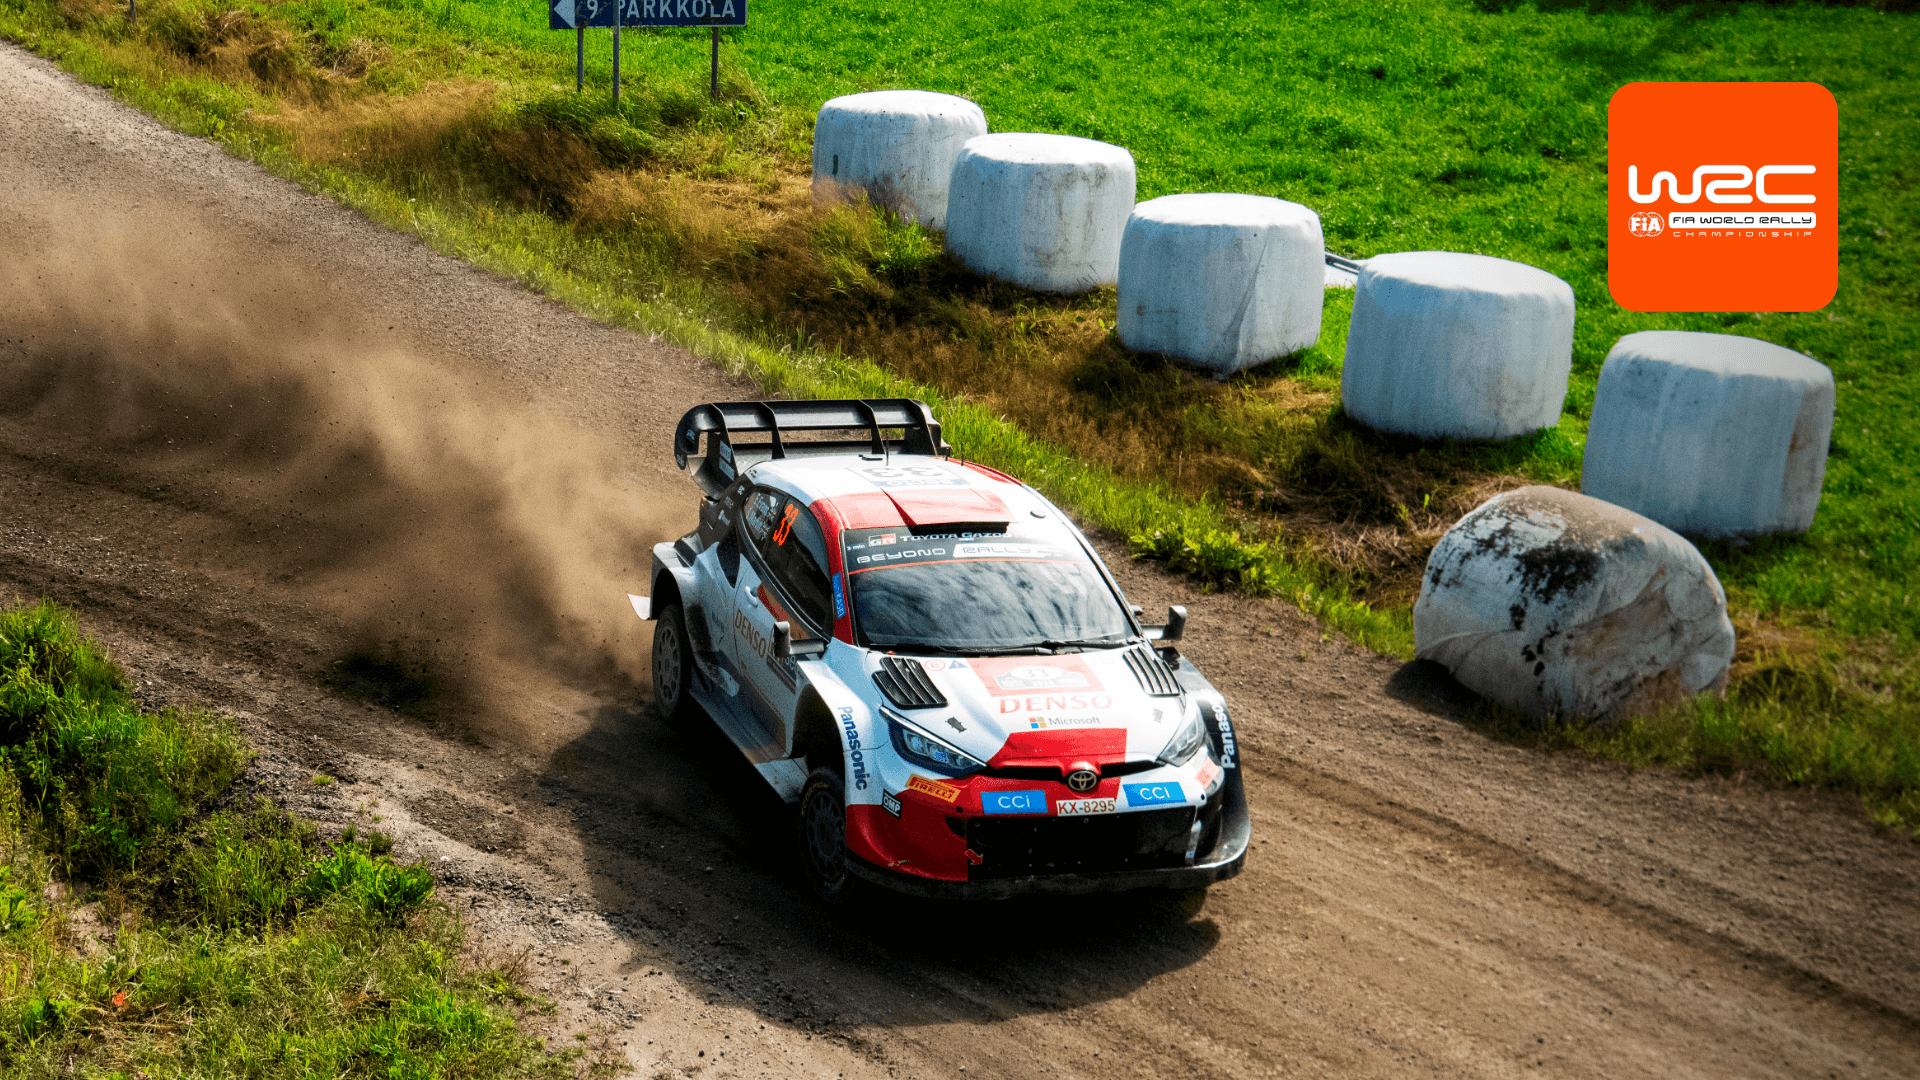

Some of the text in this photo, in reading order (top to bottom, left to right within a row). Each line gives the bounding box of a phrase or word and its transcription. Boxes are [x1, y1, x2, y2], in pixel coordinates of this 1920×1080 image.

[586, 0, 599, 19] 9
[773, 503, 799, 546] 33
[869, 534, 897, 547] GR
[899, 533, 958, 542] TOYOTA
[856, 546, 1031, 564] BEYOND RALLY
[734, 607, 768, 659] DENSO
[1021, 668, 1049, 677] 33
[999, 694, 1113, 714] DENSO
[1048, 716, 1101, 726] Microsoft
[1211, 704, 1236, 769] Panaso
[837, 706, 870, 791] Panasonic
[883, 797, 901, 812] OMP
[1058, 800, 1116, 815] KX-8295
